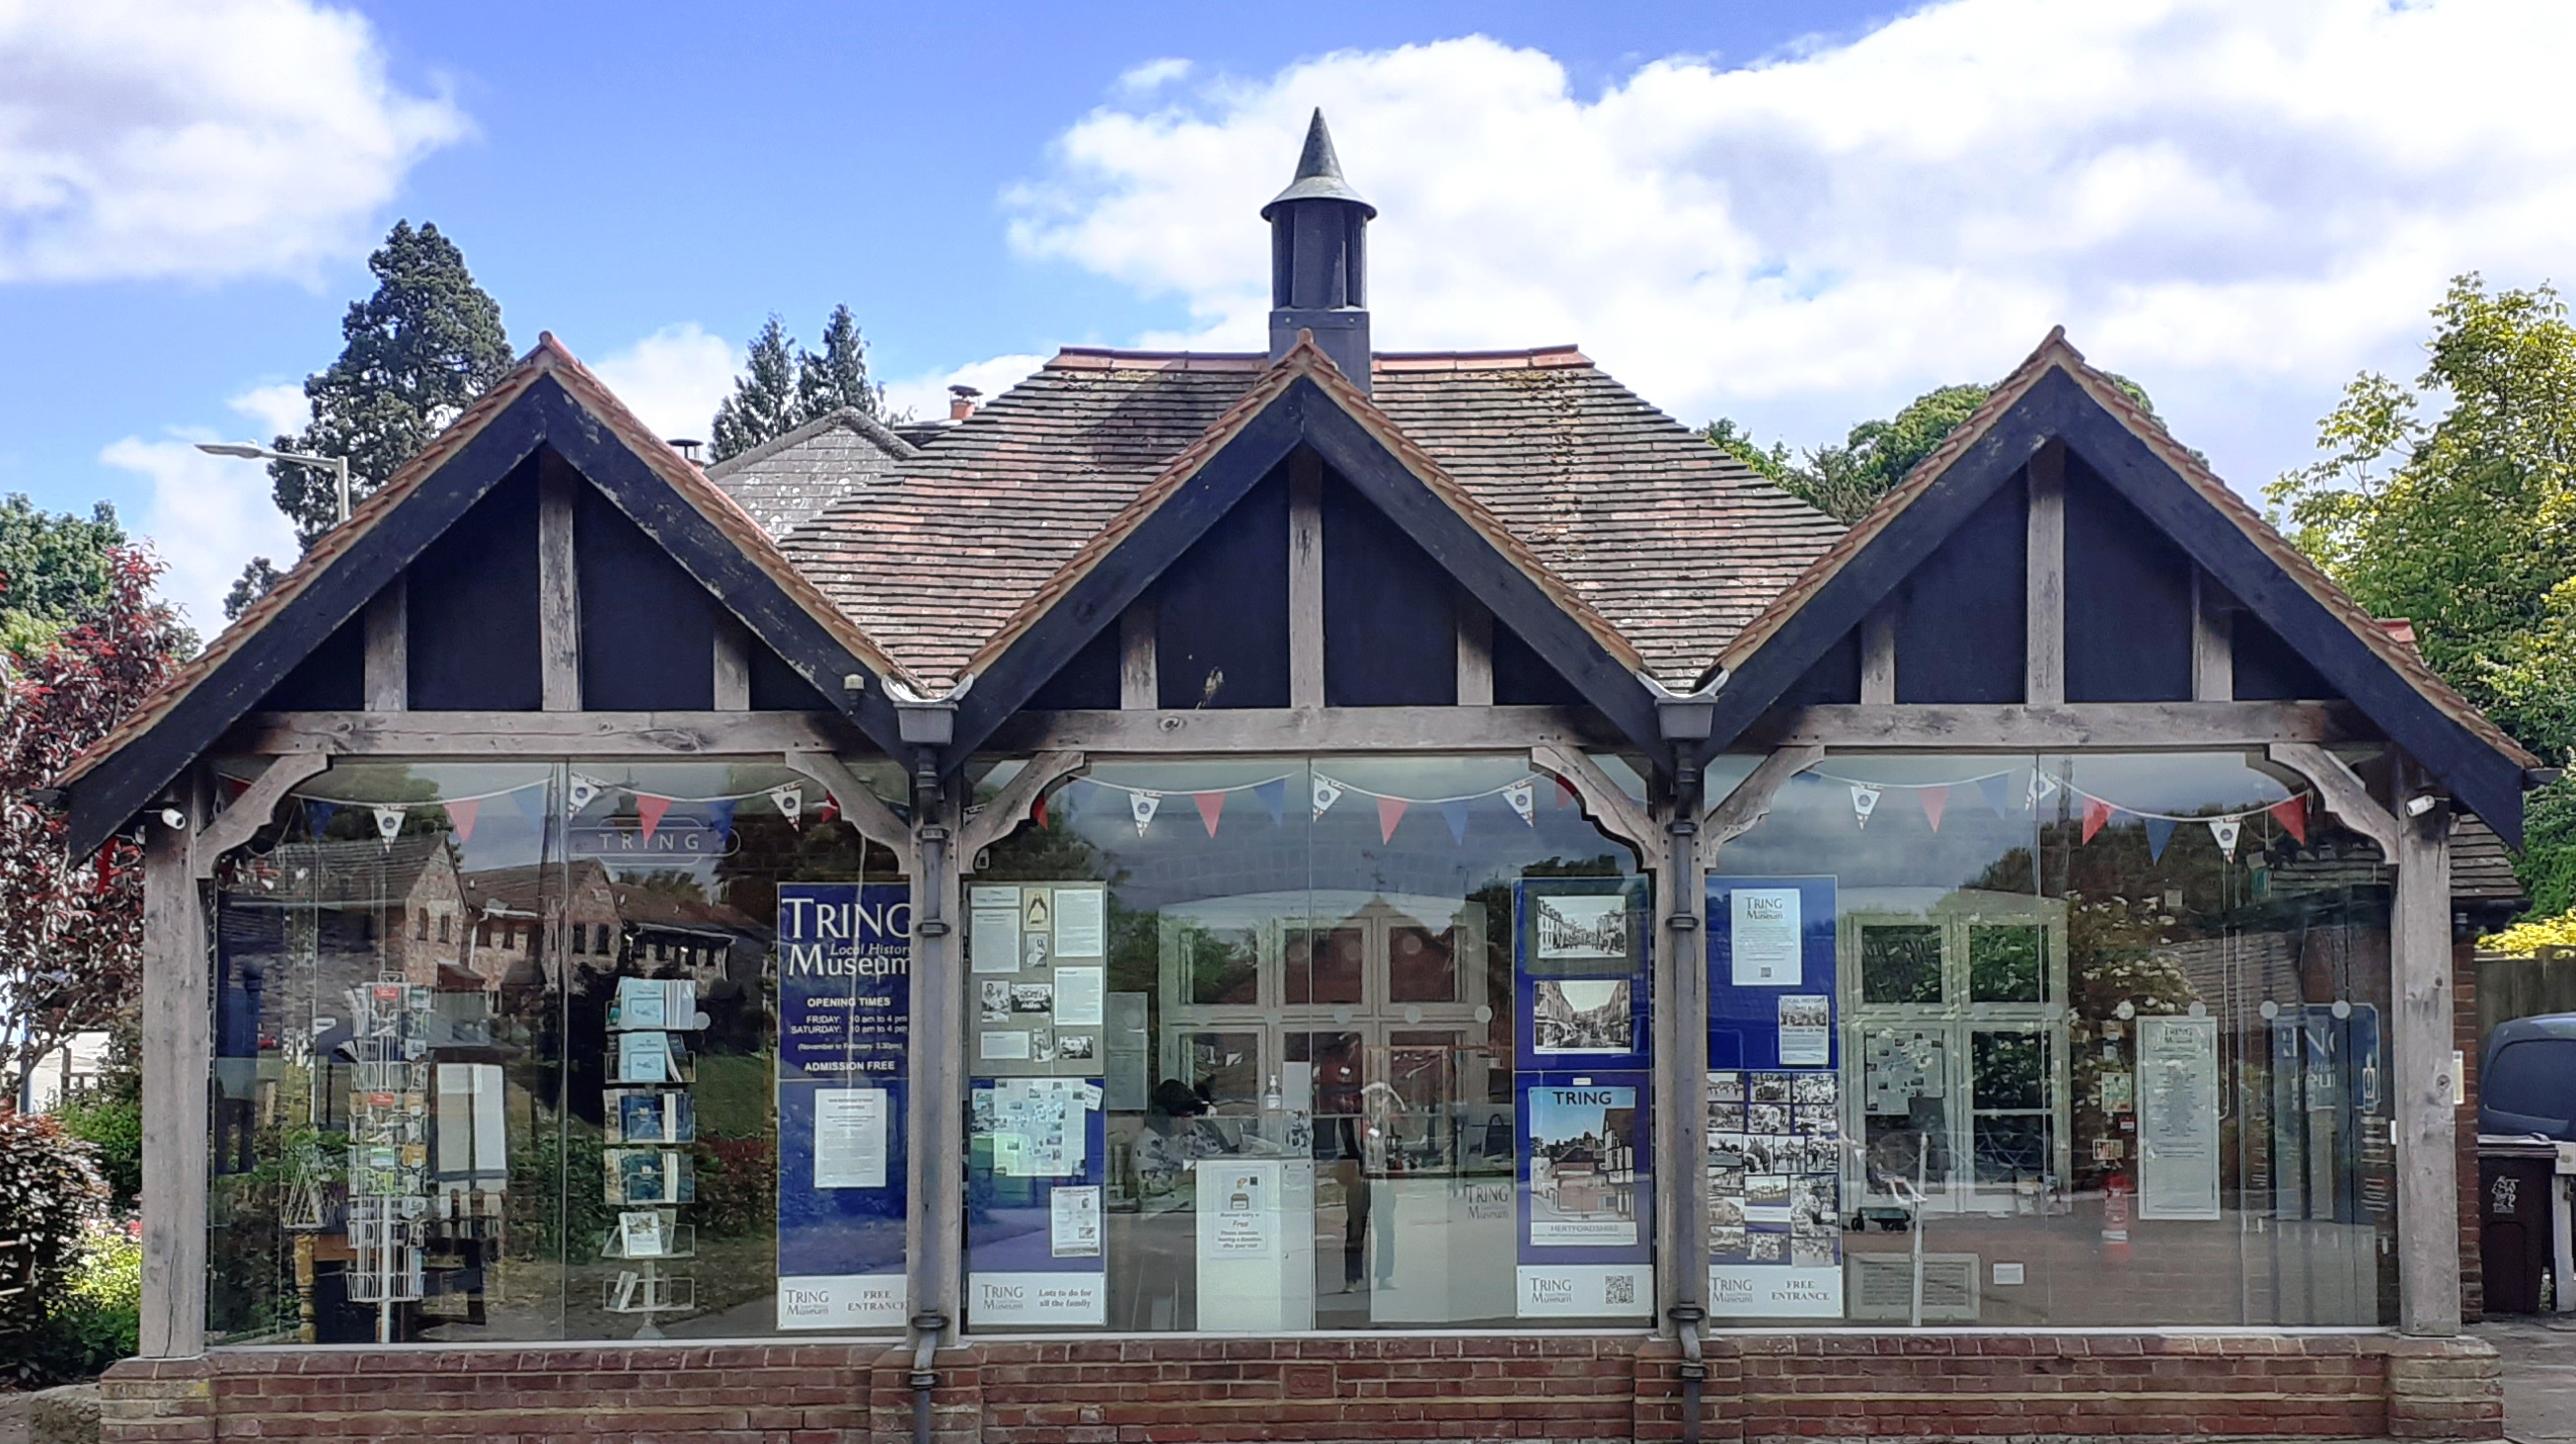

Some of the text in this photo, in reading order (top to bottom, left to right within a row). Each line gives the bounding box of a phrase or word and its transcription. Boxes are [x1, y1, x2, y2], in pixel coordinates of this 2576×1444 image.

[1745, 896, 1782, 909] TRING
[781, 897, 911, 939] TRING
[830, 944, 865, 955] Local
[806, 996, 891, 1008] OPENING TIMES
[886, 1014, 893, 1023] 4
[894, 1015, 908, 1025] pm
[876, 1025, 885, 1033] to
[886, 1025, 893, 1033] 4
[894, 1026, 908, 1034] pm
[804, 1060, 895, 1072] ADMISSION FREE
[1552, 1091, 1613, 1105] TRING
[1465, 1183, 1508, 1203] TRING
[1551, 1225, 1619, 1234] HERTFORDSHIRE
[1530, 1277, 1572, 1292] TRING
[1711, 1277, 1753, 1292] TRING
[1786, 1280, 1815, 1289] FREE
[785, 1289, 829, 1303] TRING
[863, 1290, 891, 1299] FREE
[981, 1284, 1023, 1298] TRING
[1038, 1288, 1057, 1297] Lots
[1068, 1288, 1079, 1297] do
[1080, 1288, 1093, 1297] for
[1772, 1291, 1830, 1301] ENTRANCE
[1066, 1299, 1092, 1309] family
[1532, 1292, 1572, 1304] Museum
[848, 1302, 906, 1312] ENTRANCE
